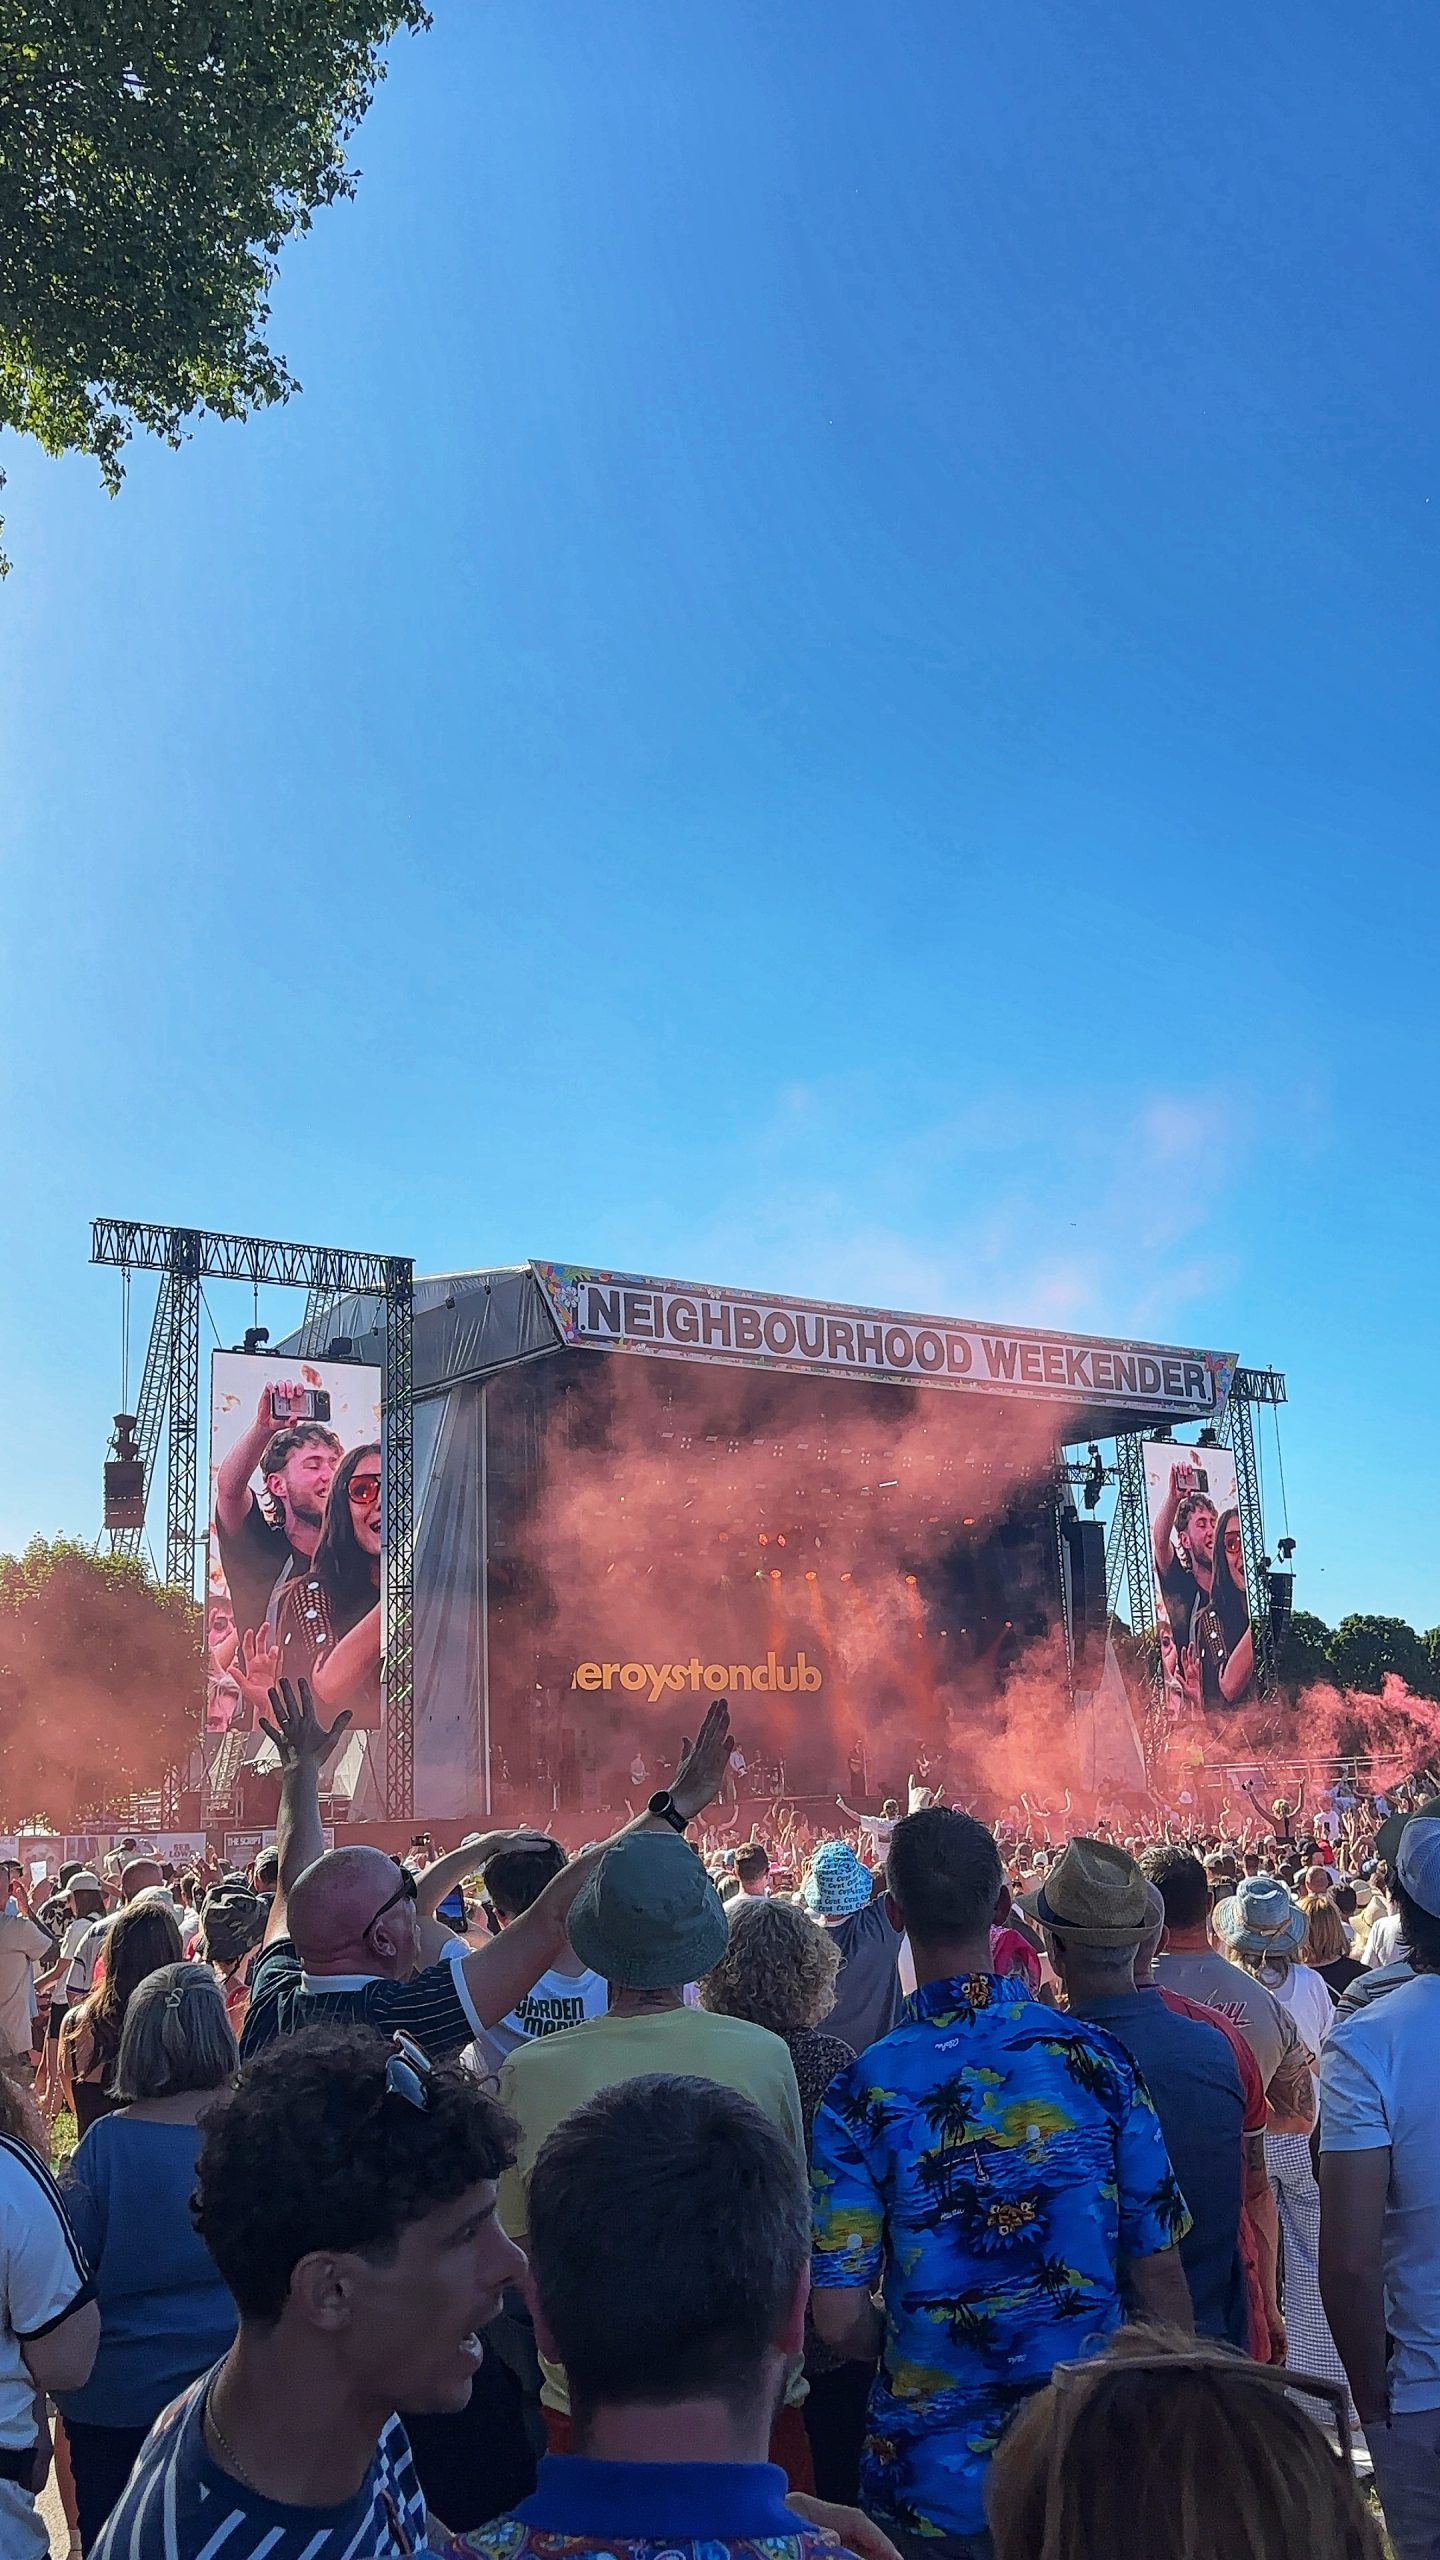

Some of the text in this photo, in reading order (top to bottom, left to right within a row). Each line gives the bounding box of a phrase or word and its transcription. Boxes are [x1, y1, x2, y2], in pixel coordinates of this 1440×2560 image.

[588, 1287, 1206, 1400] NEIGHBOURHOOD WEEKENDER
[571, 1651, 822, 1702] eroystonclub
[169, 1850, 191, 1858] LOW
[227, 1837, 240, 1847] THE
[241, 1836, 261, 1845] SCRIPT
